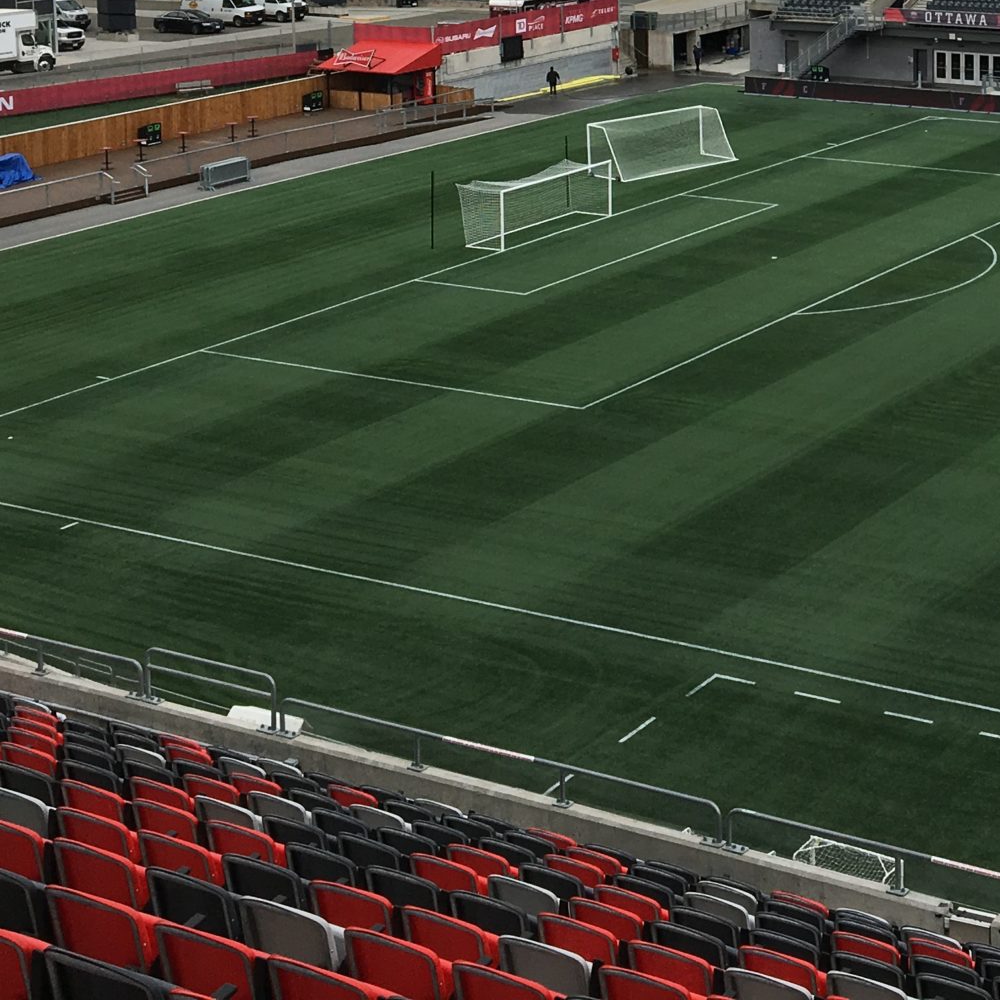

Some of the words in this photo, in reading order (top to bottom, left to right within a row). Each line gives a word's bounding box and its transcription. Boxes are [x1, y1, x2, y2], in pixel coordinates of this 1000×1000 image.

[565, 13, 584, 25] KPMG
[924, 11, 988, 26] OTTAWA
[444, 33, 471, 42] SUBARU
